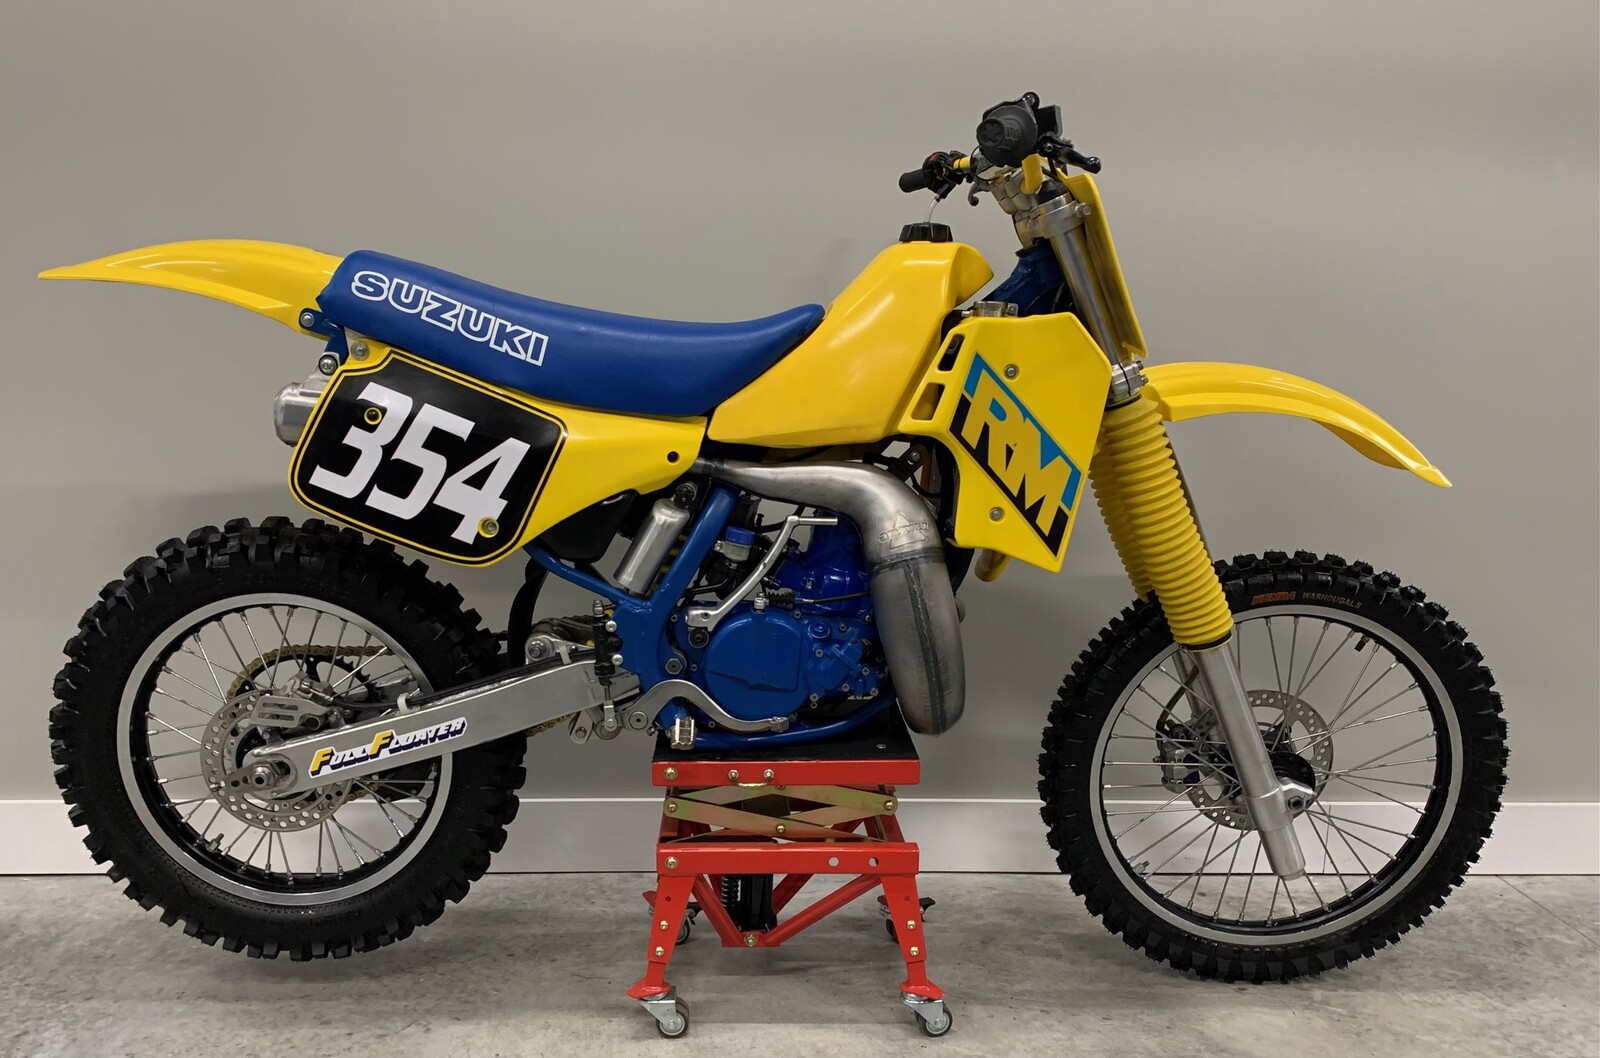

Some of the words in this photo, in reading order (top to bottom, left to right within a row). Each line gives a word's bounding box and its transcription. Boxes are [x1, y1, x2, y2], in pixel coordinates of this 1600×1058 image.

[351, 271, 549, 366] SUZUKI
[308, 381, 531, 545] 354
[961, 368, 1072, 537] RM
[1251, 591, 1297, 605] KENDA
[1302, 592, 1355, 607] WASHOUGAL
